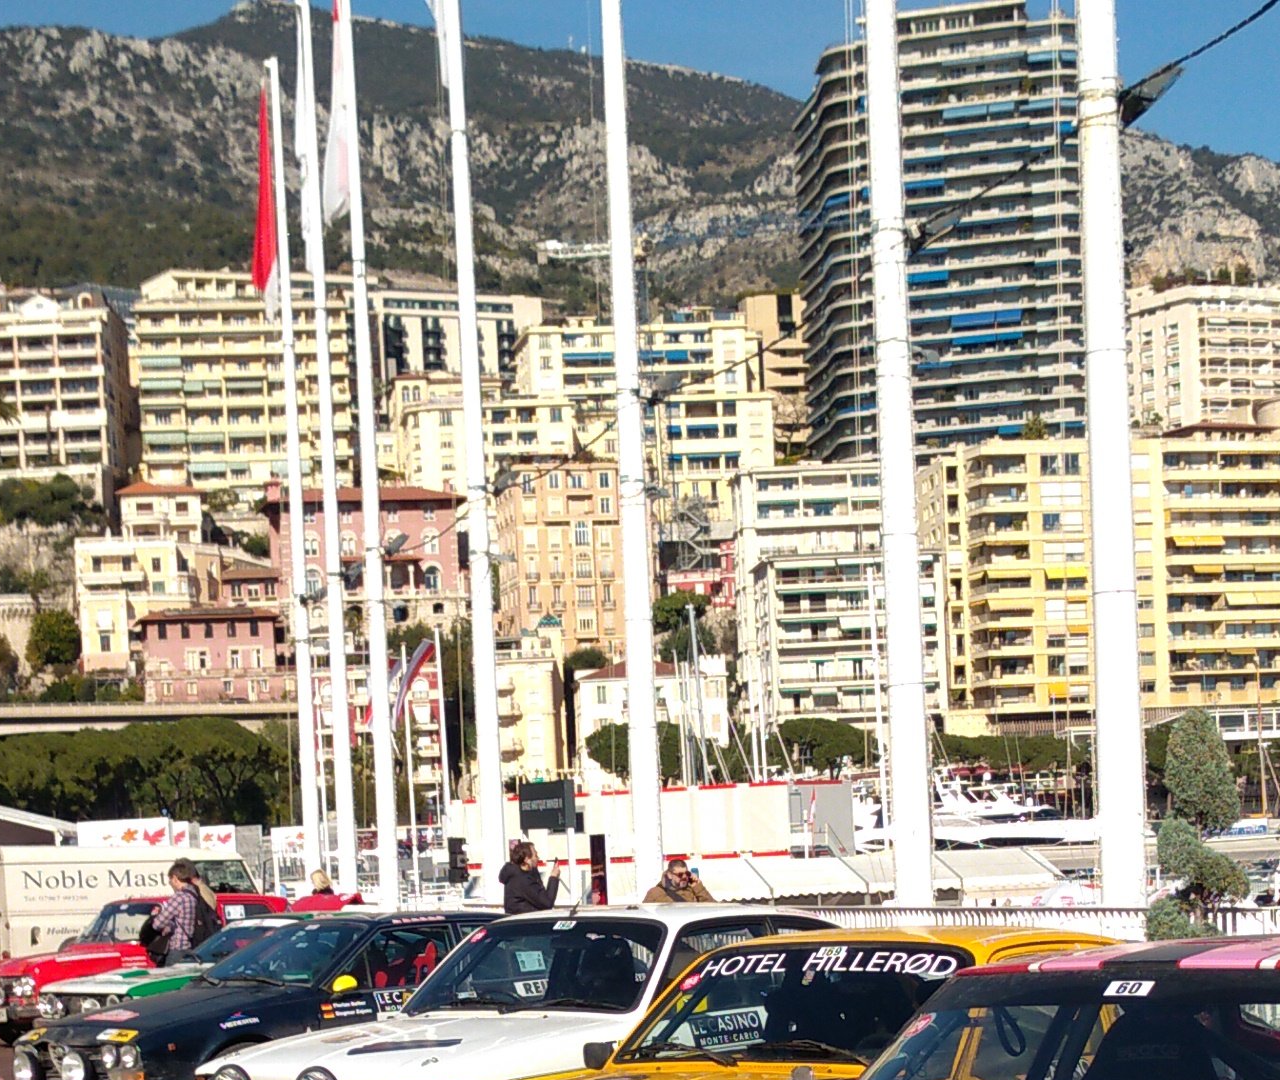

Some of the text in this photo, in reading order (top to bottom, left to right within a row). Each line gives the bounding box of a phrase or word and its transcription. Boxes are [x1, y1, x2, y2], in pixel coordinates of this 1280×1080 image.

[22, 869, 172, 890] Noble Mast
[822, 946, 842, 956] 169
[700, 951, 958, 979] HOTEL HILLERØD
[1115, 981, 1143, 995] 60
[692, 1012, 758, 1035] LE CASINO
